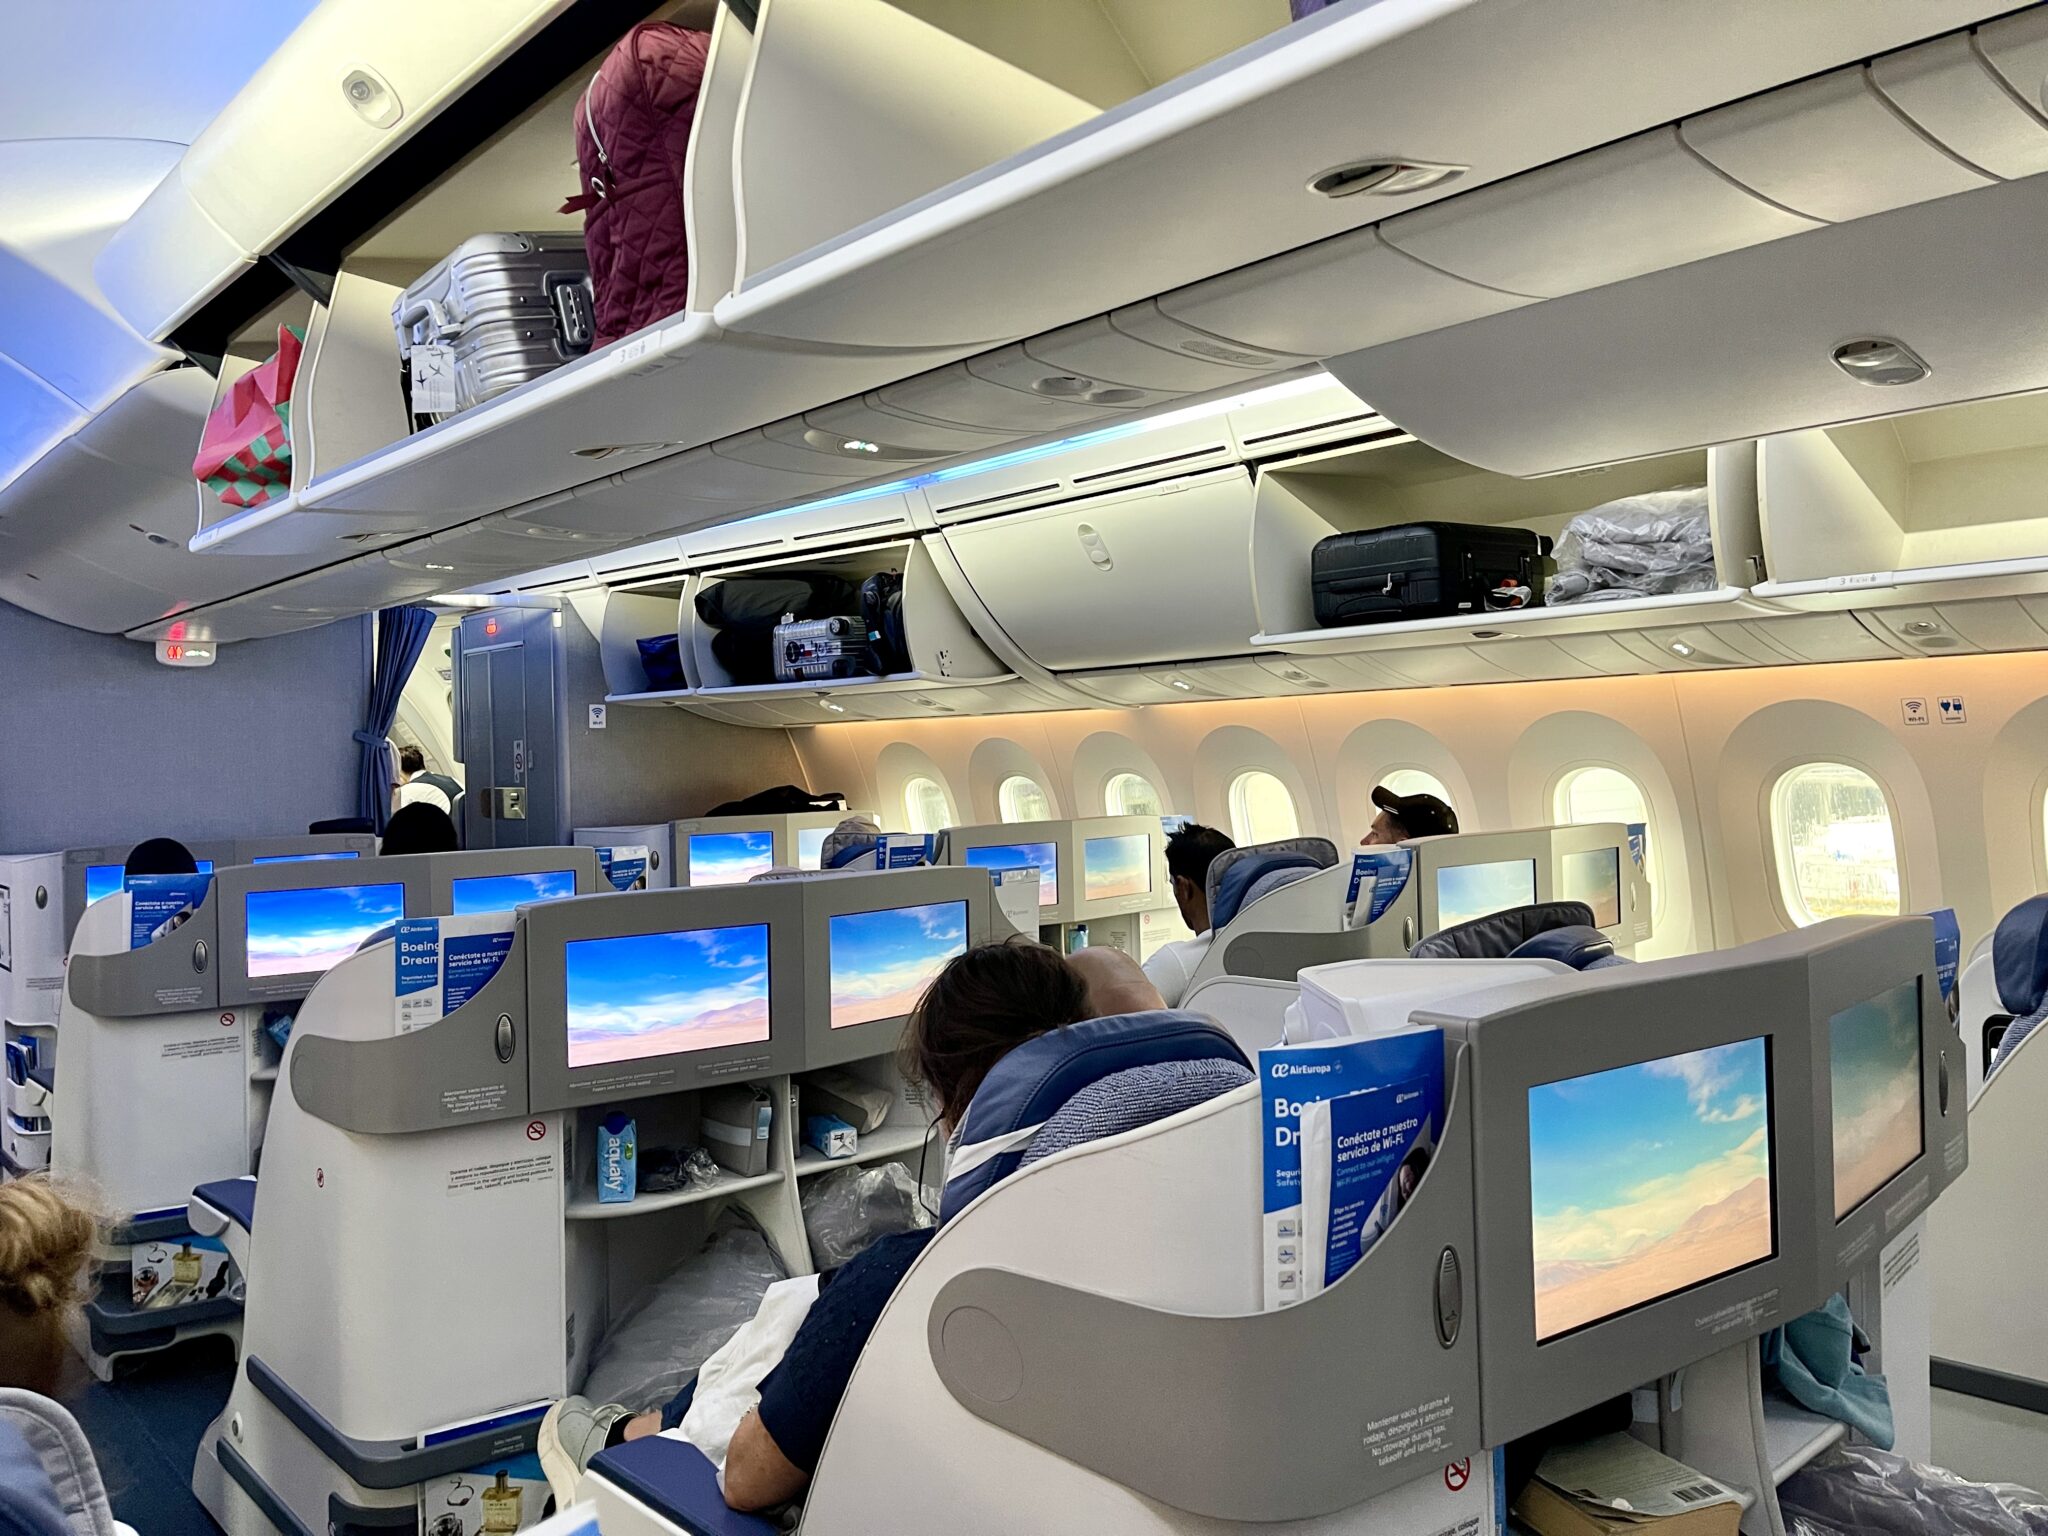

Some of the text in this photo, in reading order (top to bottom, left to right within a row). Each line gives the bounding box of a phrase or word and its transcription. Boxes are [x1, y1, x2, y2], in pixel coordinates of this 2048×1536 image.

[1290, 1064, 1331, 1075] AirEuropa
[1338, 1118, 1418, 1149] Conéctate a nuestro
[604, 1138, 623, 1189] aqualy
[1338, 1144, 1370, 1162] servicio
[1371, 1141, 1381, 1152] de
